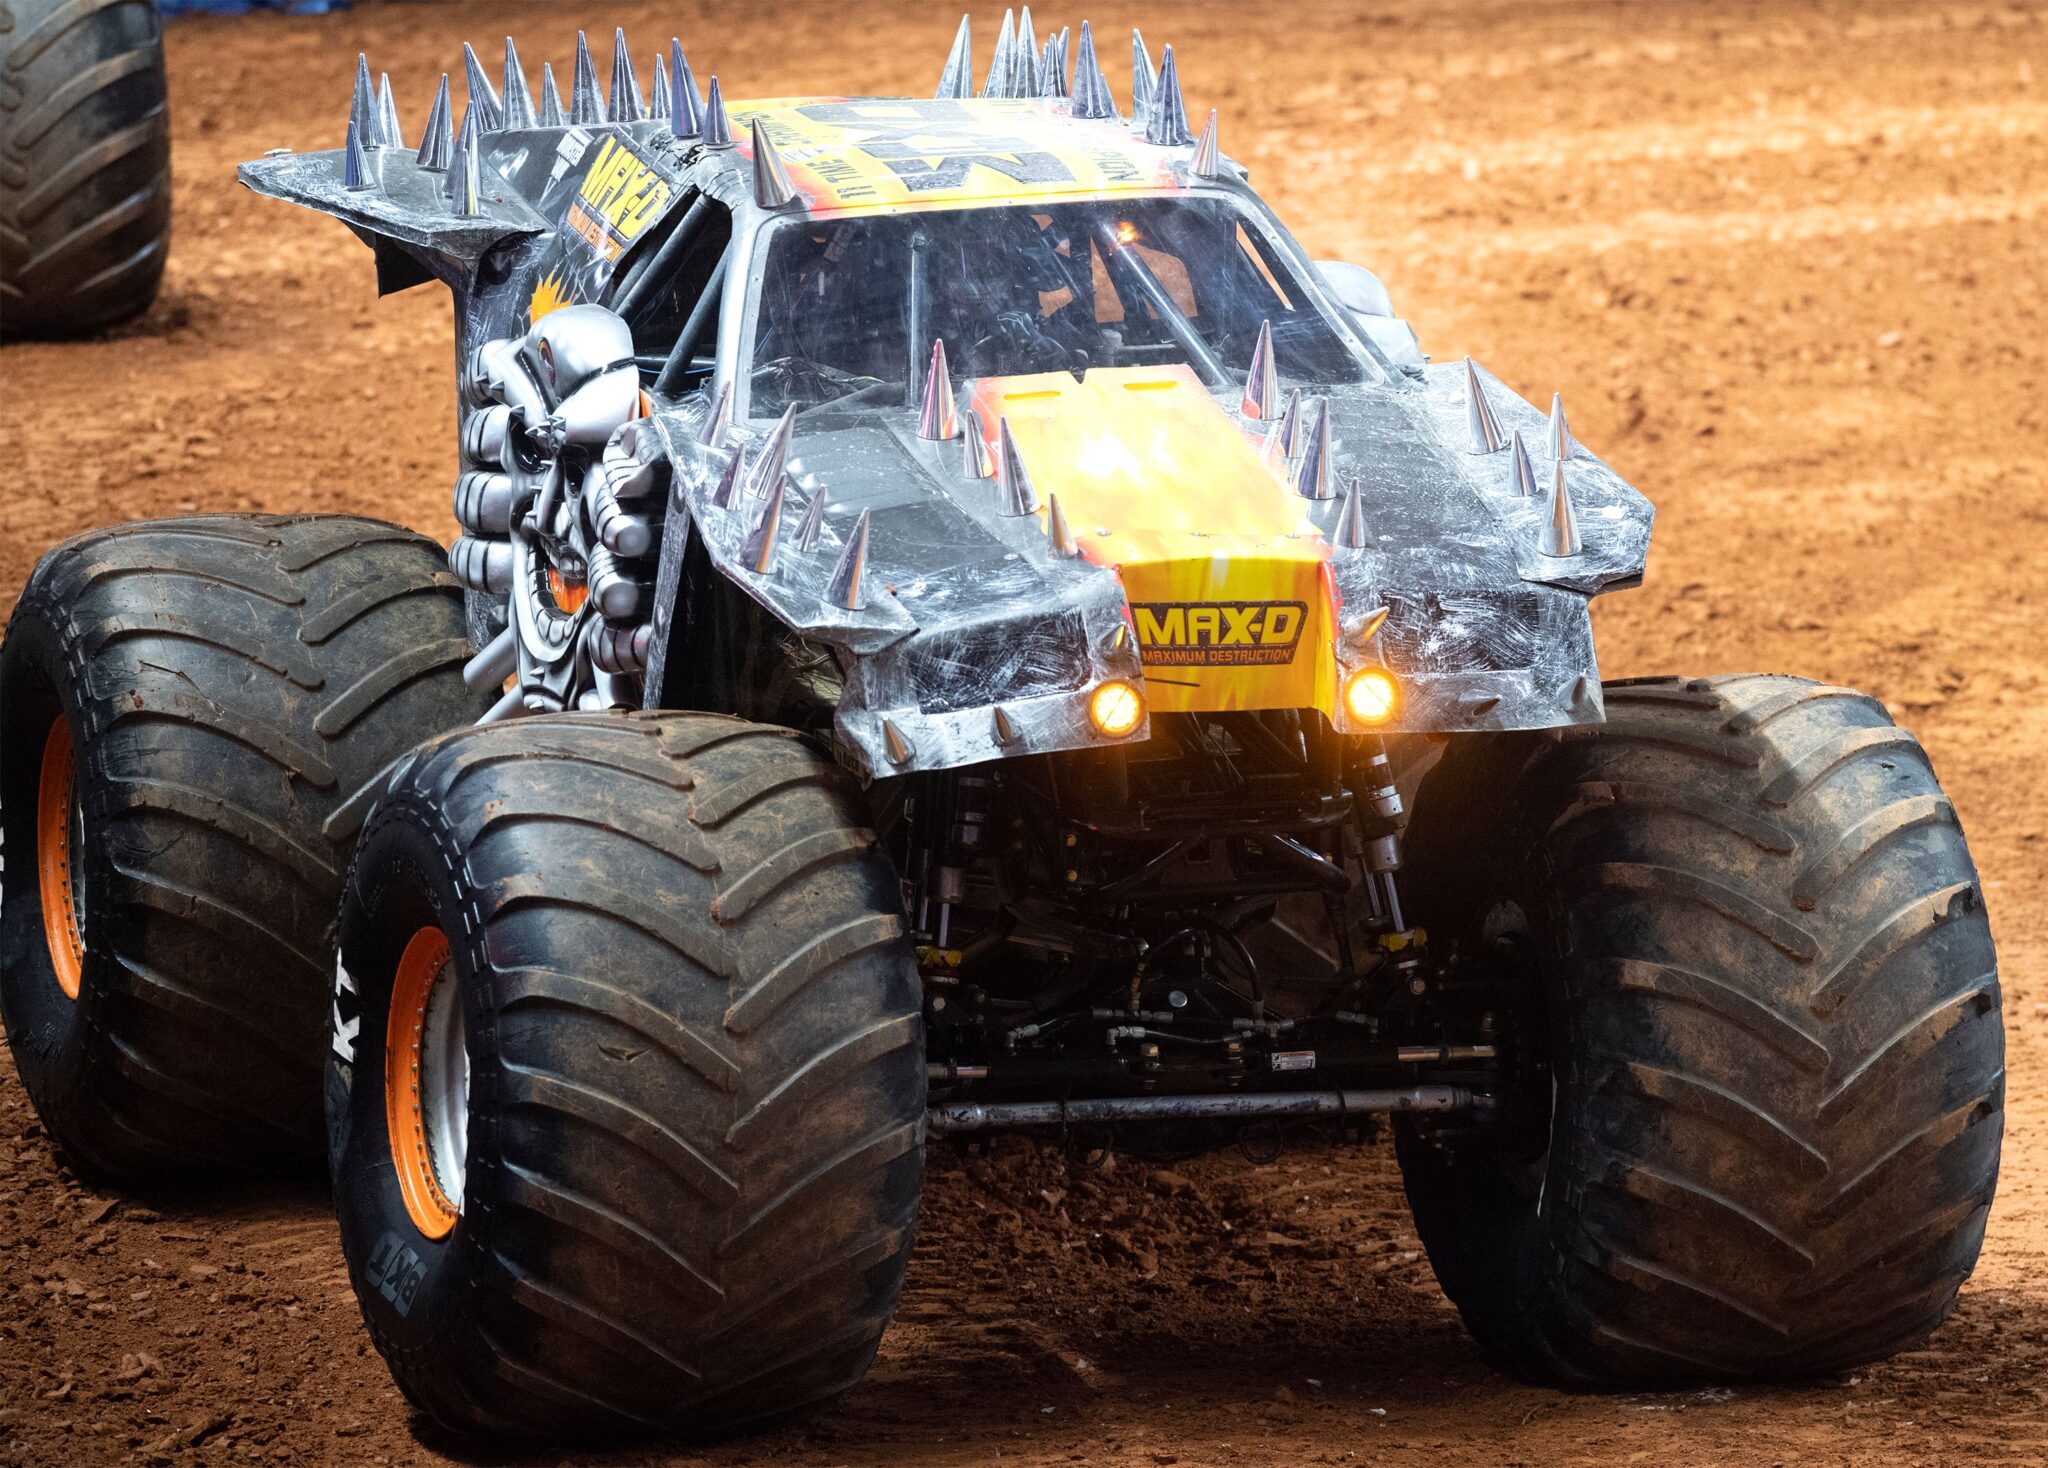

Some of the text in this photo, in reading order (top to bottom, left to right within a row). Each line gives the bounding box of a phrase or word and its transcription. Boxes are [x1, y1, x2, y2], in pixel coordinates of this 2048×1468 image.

[1134, 606, 1301, 645] MAX-D
[1142, 649, 1290, 663] MAXIMUM DESTRUCTION
[367, 1240, 421, 1308] BKT
